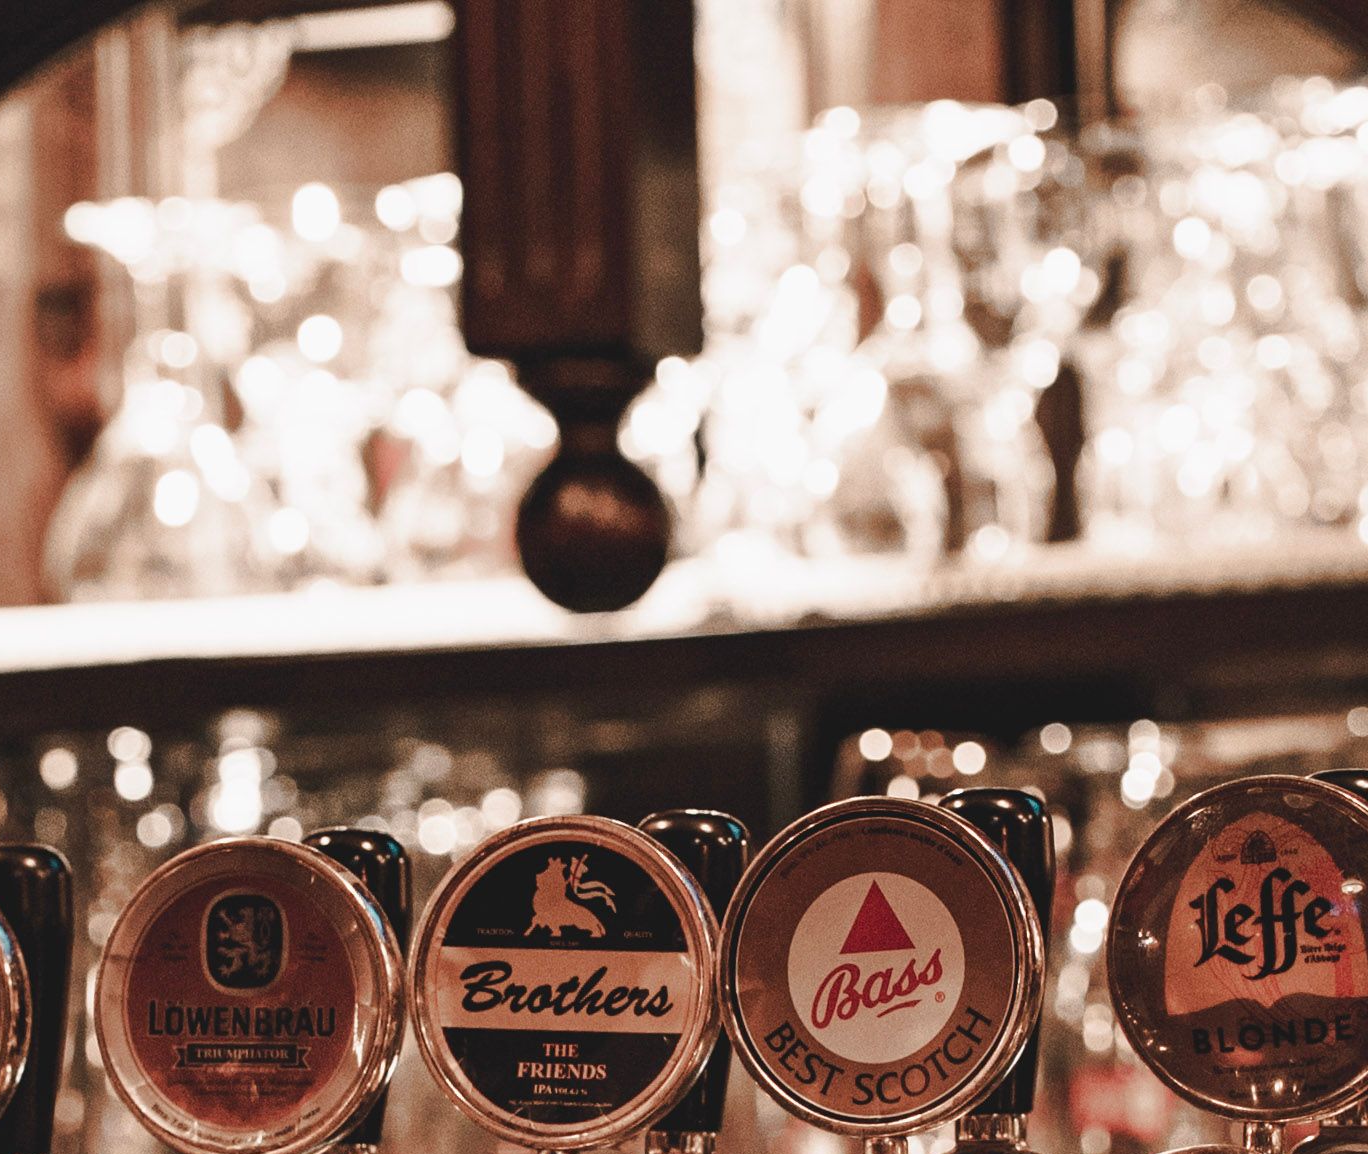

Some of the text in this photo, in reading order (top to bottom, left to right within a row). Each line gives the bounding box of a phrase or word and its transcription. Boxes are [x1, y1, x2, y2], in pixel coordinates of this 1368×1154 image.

[1189, 867, 1334, 982] Leffe
[459, 960, 674, 1018] Brothers
[810, 948, 943, 1029] Bass
[148, 999, 336, 1037] LÖWENBRÄU
[1191, 1014, 1354, 1055] BLONDE
[196, 1048, 290, 1060] TRIUMPHATOR
[542, 1043, 579, 1057] THE
[763, 1006, 993, 1105] BEST SCOTCH
[516, 1061, 608, 1081] FRIENDS
[533, 1083, 553, 1095] IPA
